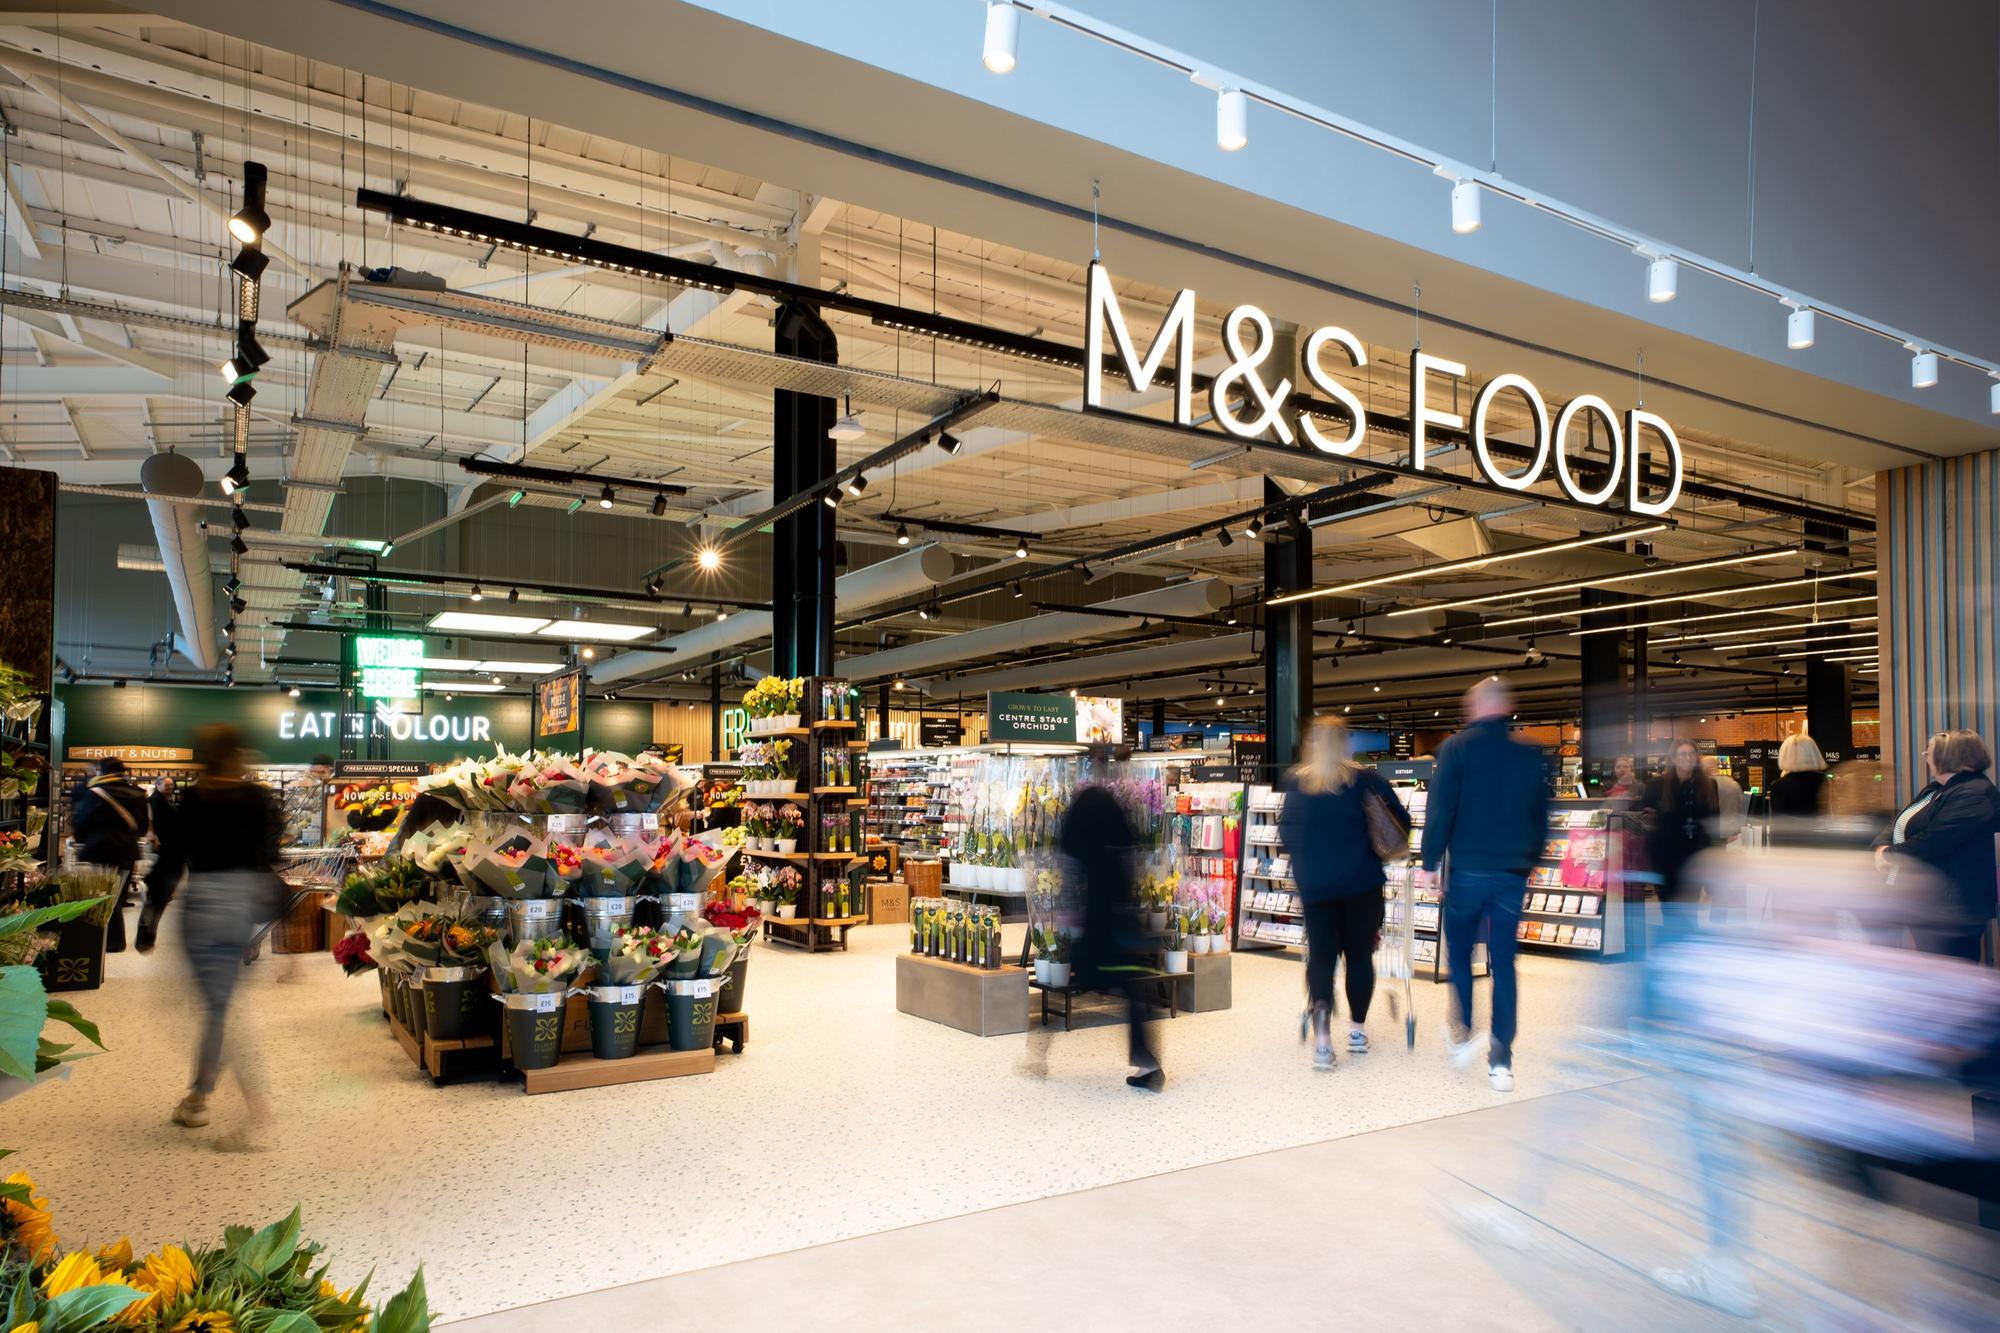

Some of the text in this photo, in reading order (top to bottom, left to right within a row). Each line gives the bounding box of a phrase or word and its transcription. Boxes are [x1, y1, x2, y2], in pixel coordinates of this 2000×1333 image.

[1084, 262, 1684, 516] M&S FOOD
[1008, 704, 1031, 712] GROWN
[998, 713, 1069, 724] CENTRE STAGE
[280, 712, 336, 739] EAT
[1013, 722, 1056, 731] ORCHIDS
[86, 748, 126, 758] FRUIT
[128, 749, 137, 758] &
[141, 749, 177, 759] NUTS
[1768, 748, 1780, 757] M&
[388, 765, 419, 773] SPECIALS
[343, 792, 366, 800] NOW
[379, 791, 417, 800] SEASON
[881, 898, 900, 907] M&S
[624, 992, 635, 1000] £15
